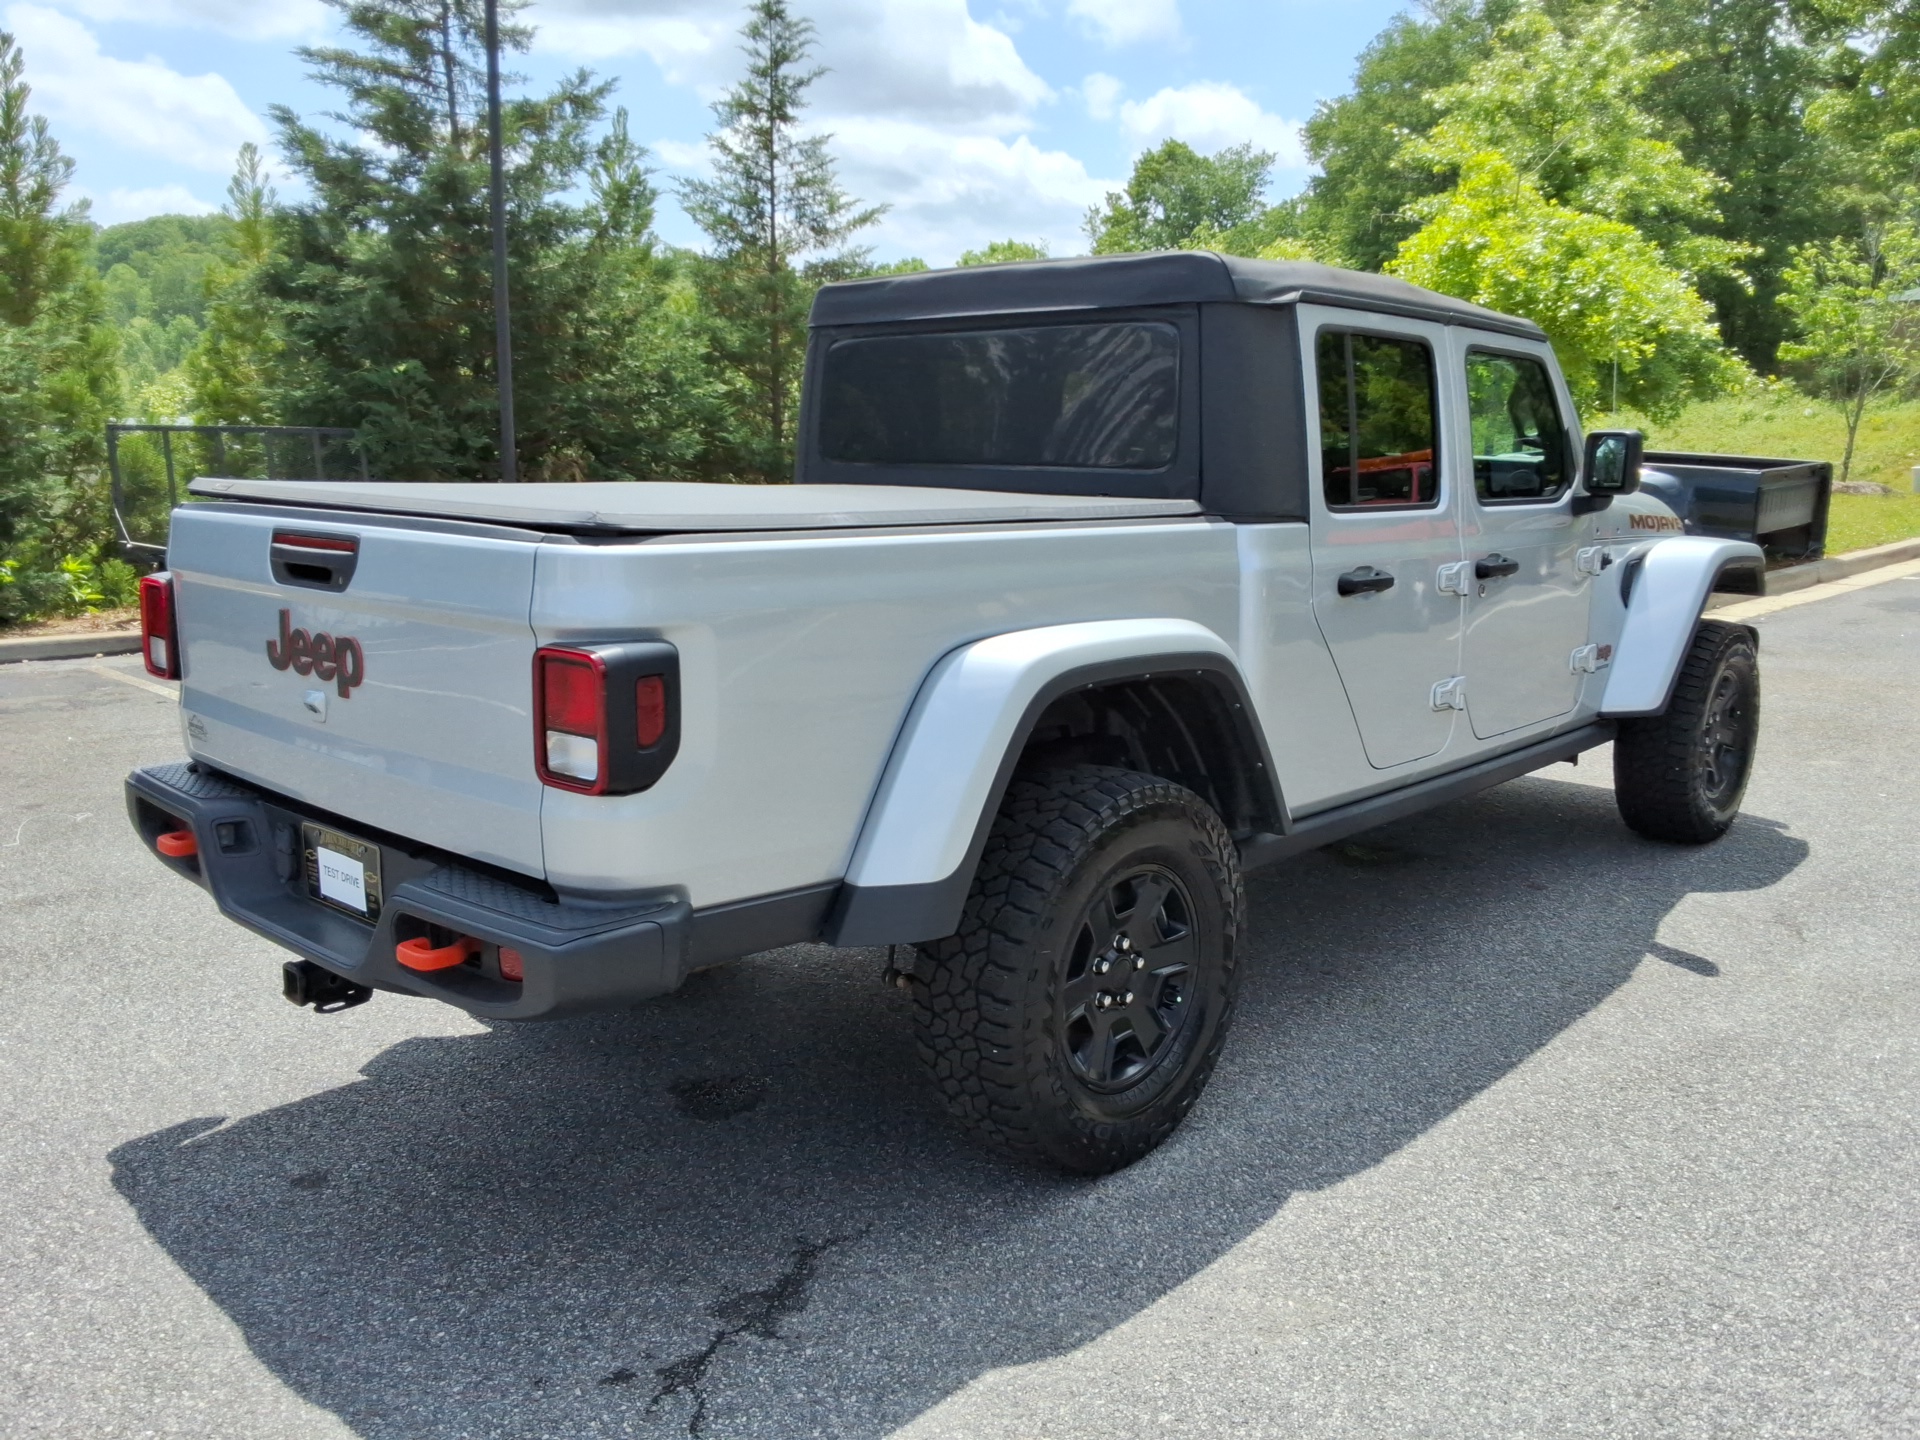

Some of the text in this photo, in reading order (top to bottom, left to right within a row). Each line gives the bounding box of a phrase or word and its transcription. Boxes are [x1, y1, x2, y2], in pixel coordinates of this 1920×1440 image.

[1629, 514, 1683, 532] MOJAVE
[266, 608, 364, 699] Jeep
[323, 864, 339, 880] TEST
[341, 870, 361, 889] DRIVE
